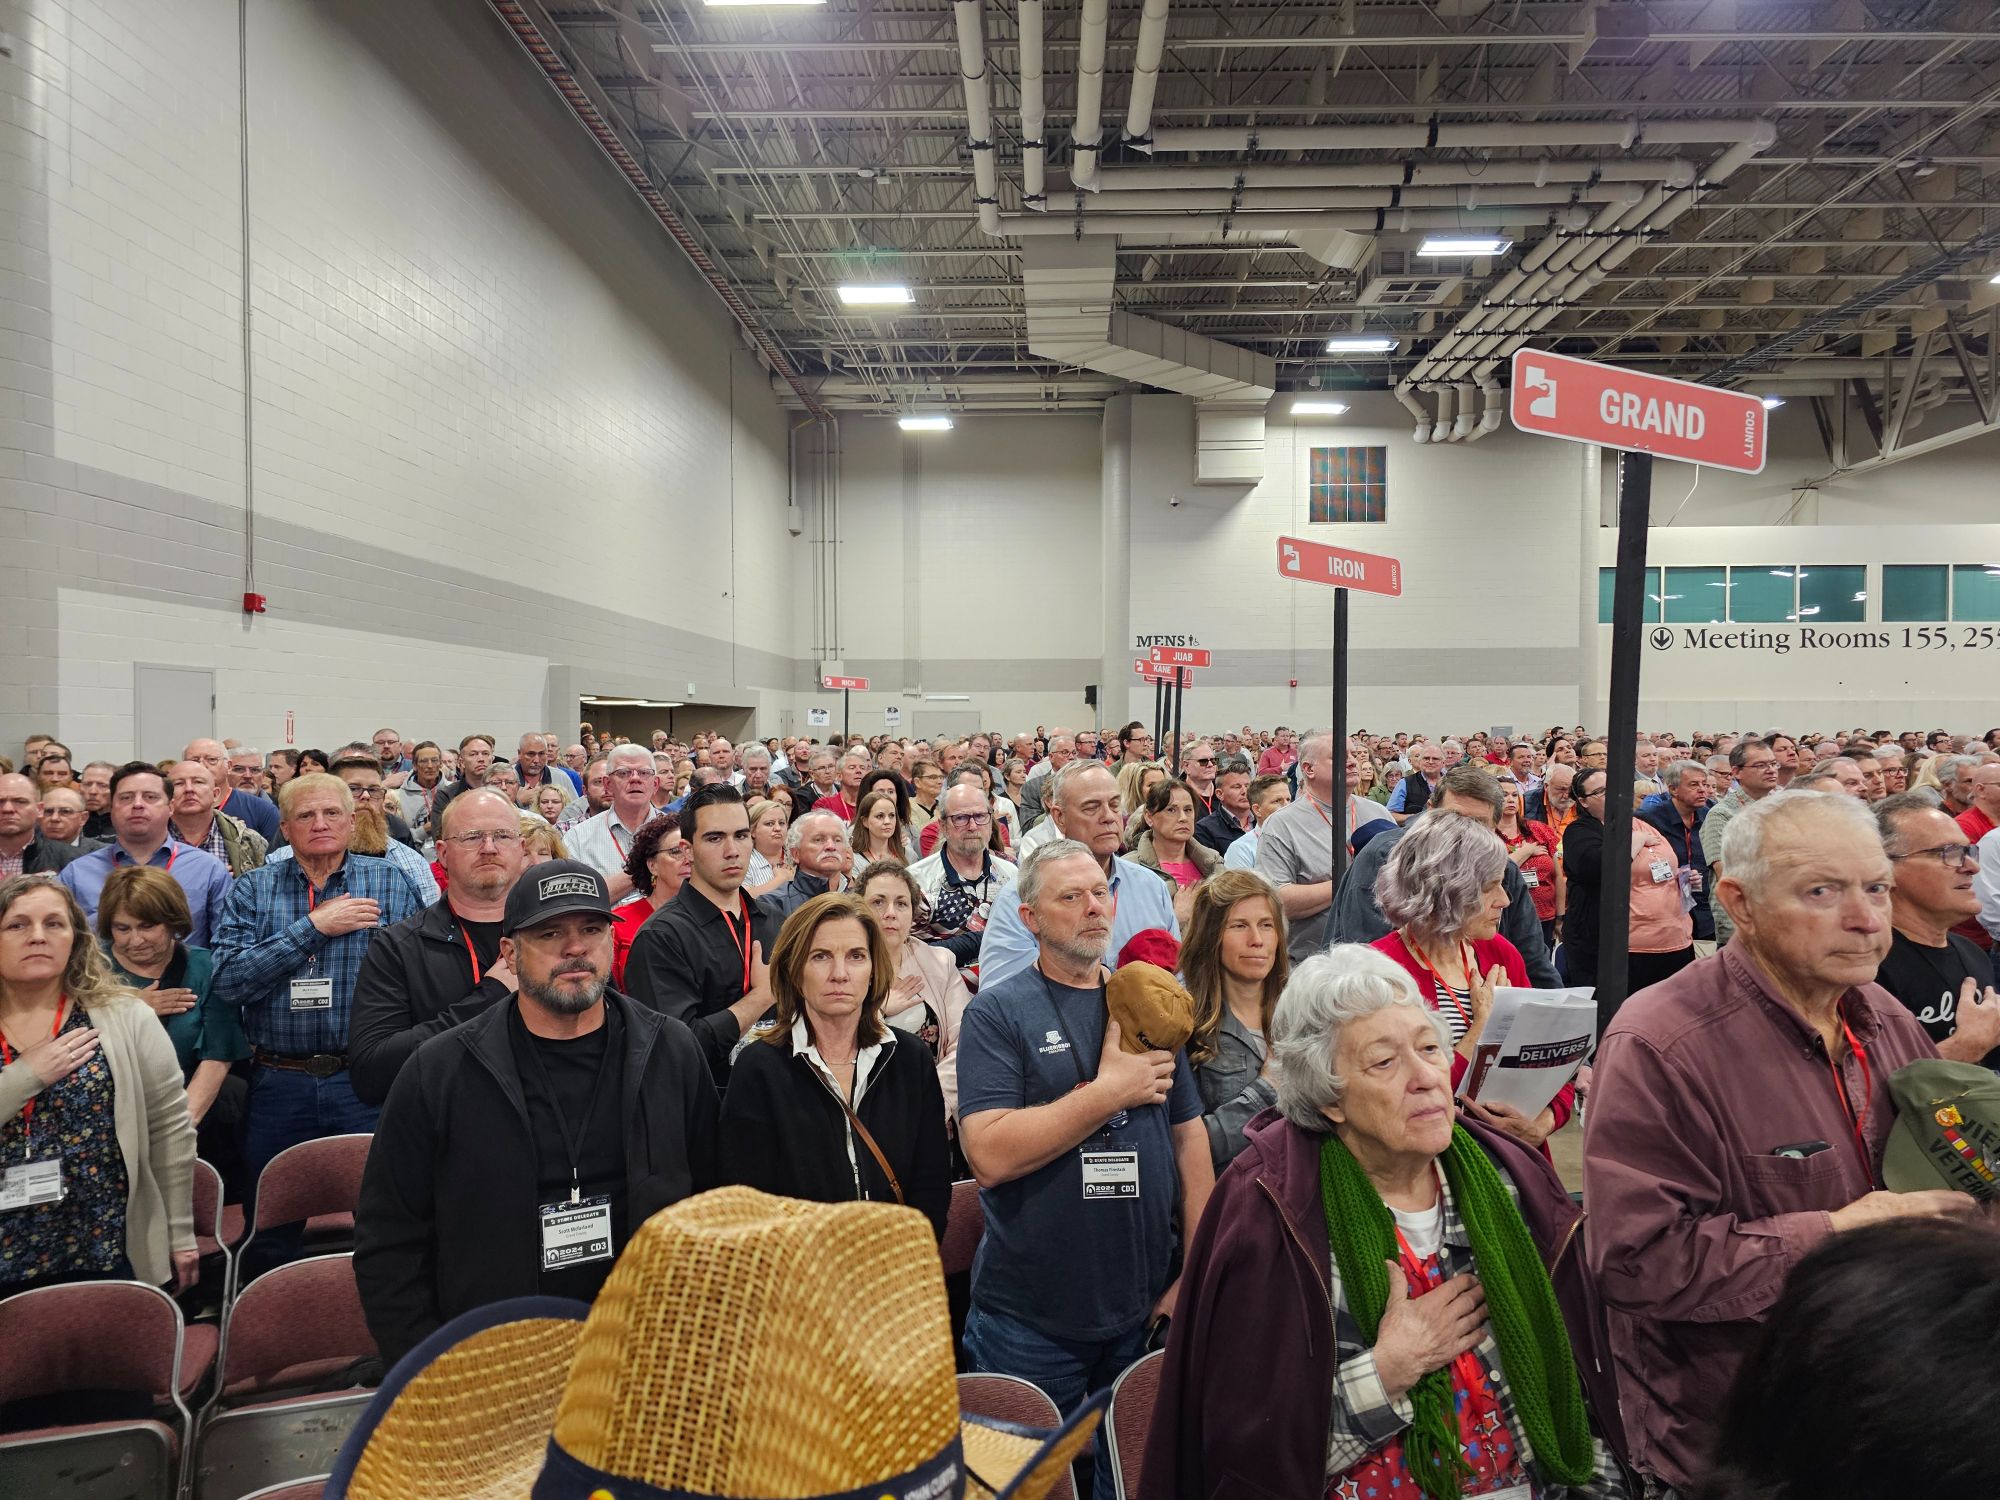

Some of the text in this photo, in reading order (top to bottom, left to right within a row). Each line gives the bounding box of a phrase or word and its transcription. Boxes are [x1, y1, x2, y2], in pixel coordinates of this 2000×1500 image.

[1600, 388, 1706, 440] GRAND
[1743, 410, 1756, 458] COUNTY
[1328, 556, 1365, 580] IRON
[1136, 635, 1185, 648] MENS
[1684, 628, 1790, 654] Meeting
[1800, 627, 1890, 649] Rooms
[1902, 626, 1955, 652] 155,
[1173, 652, 1193, 662] JUAB
[1153, 664, 1172, 674] KANE
[841, 679, 856, 688] RICH
[1520, 1042, 1586, 1061] DELIVERS
[1121, 1184, 1135, 1193] CD3
[560, 1246, 583, 1256] 2024
[590, 1241, 607, 1252] CD3
